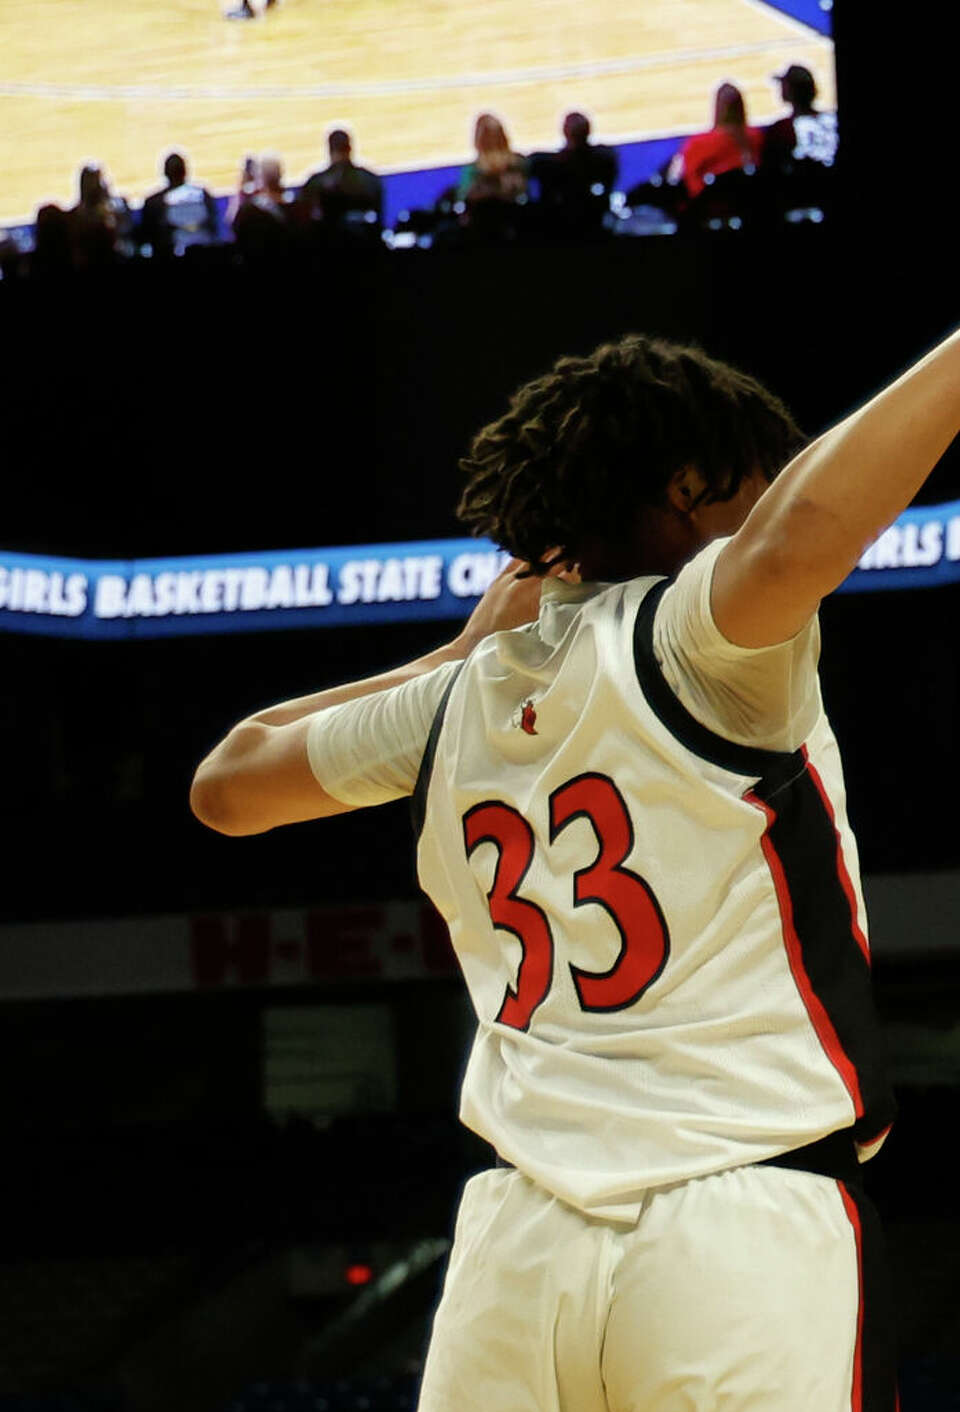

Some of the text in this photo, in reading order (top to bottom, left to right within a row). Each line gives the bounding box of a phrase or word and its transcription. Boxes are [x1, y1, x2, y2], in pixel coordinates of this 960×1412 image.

[94, 563, 332, 618] BASKETBALL
[337, 556, 442, 604] STATE
[463, 771, 671, 1034] 33
